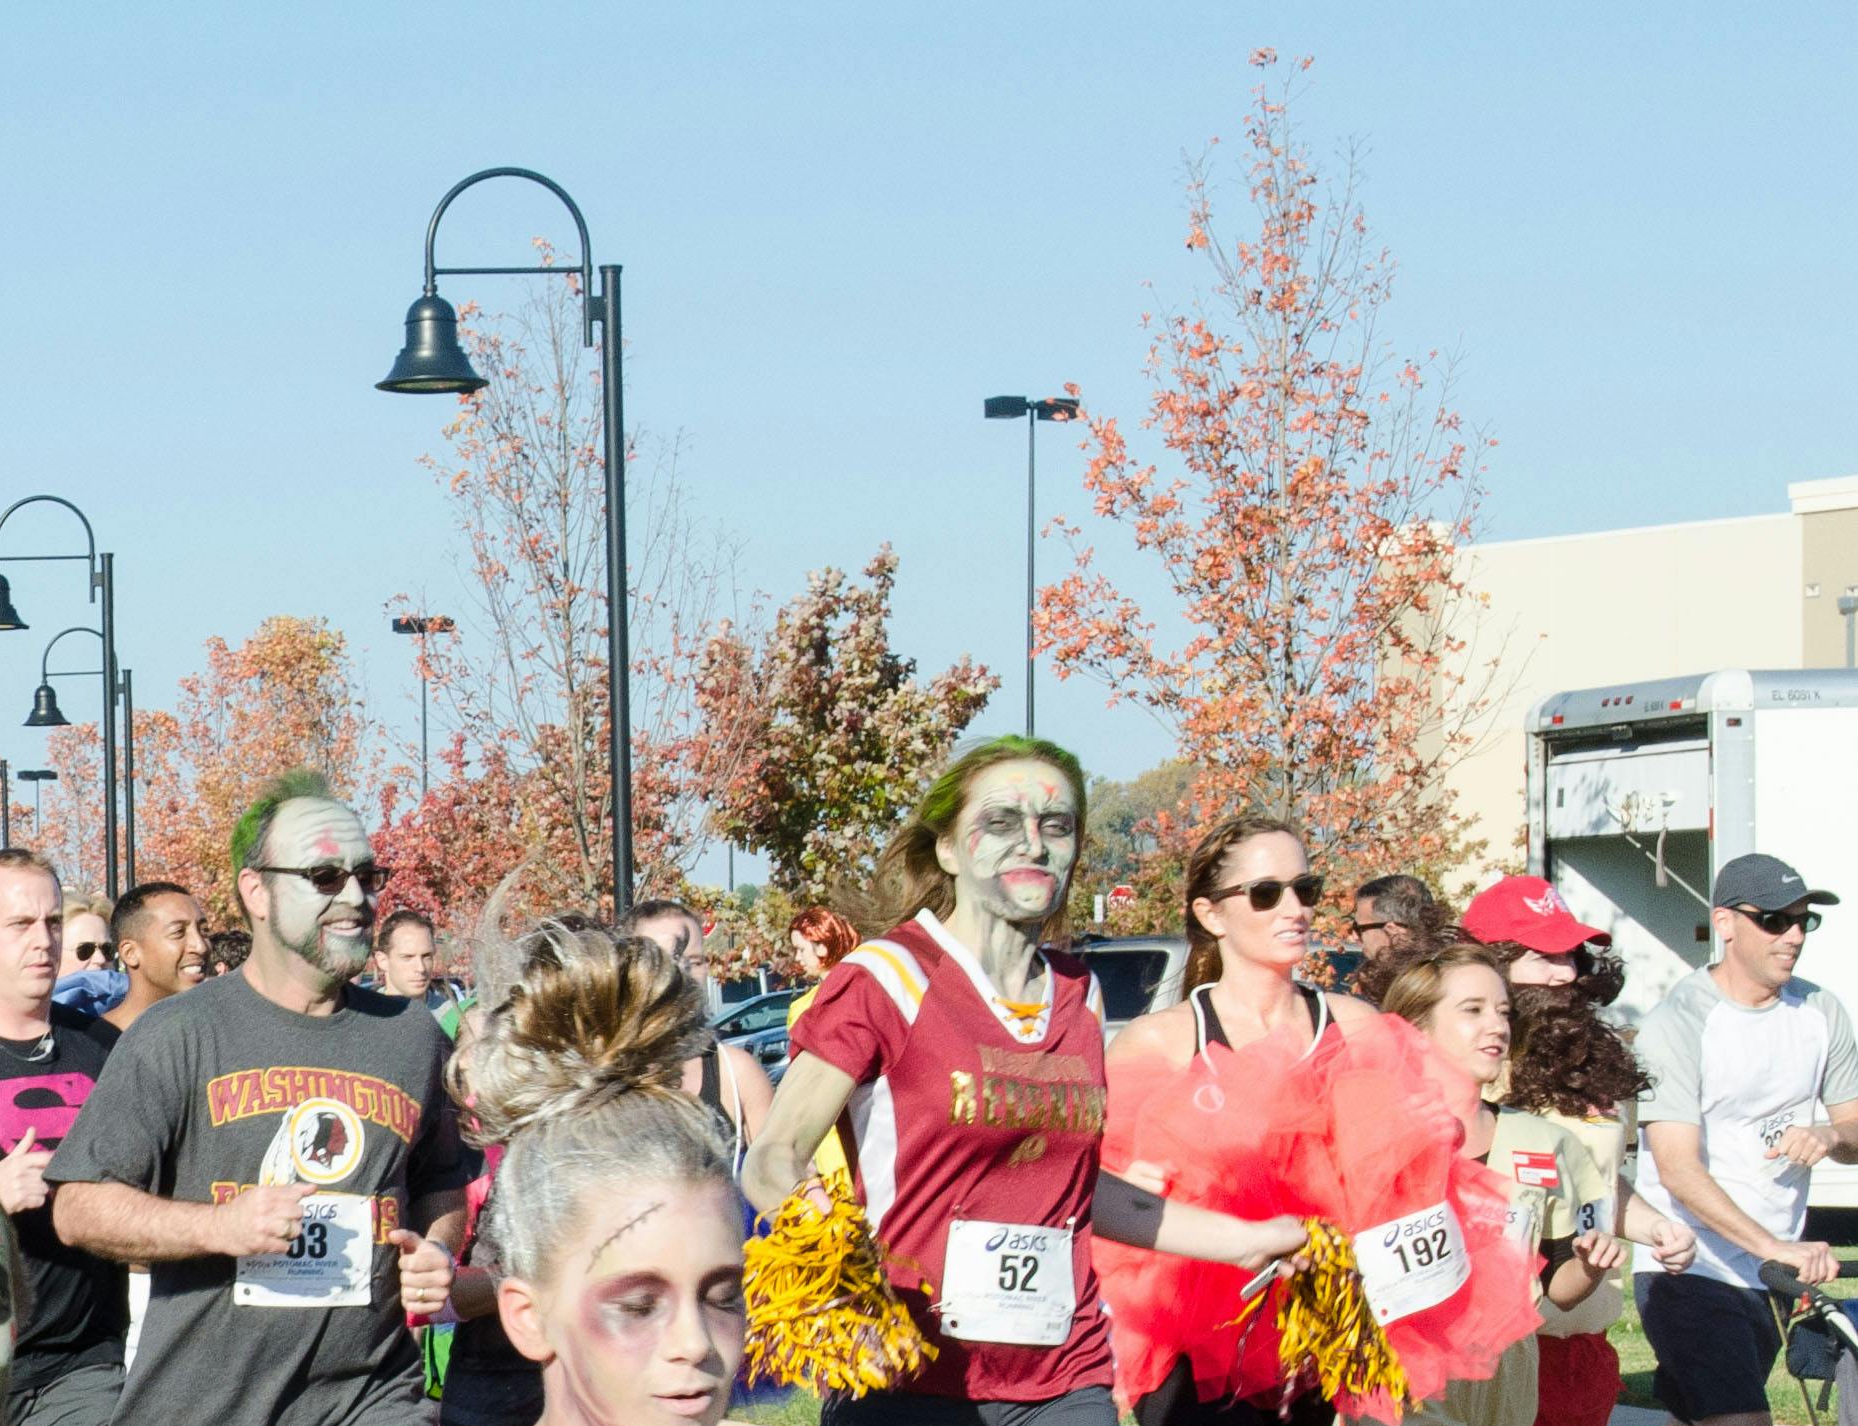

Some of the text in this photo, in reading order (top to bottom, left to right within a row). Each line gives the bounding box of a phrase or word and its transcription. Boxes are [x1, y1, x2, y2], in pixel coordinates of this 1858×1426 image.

[949, 1071, 1108, 1135] REDSKIN
[998, 1254, 1040, 1293] 52
[1392, 1228, 1452, 1274] 192
